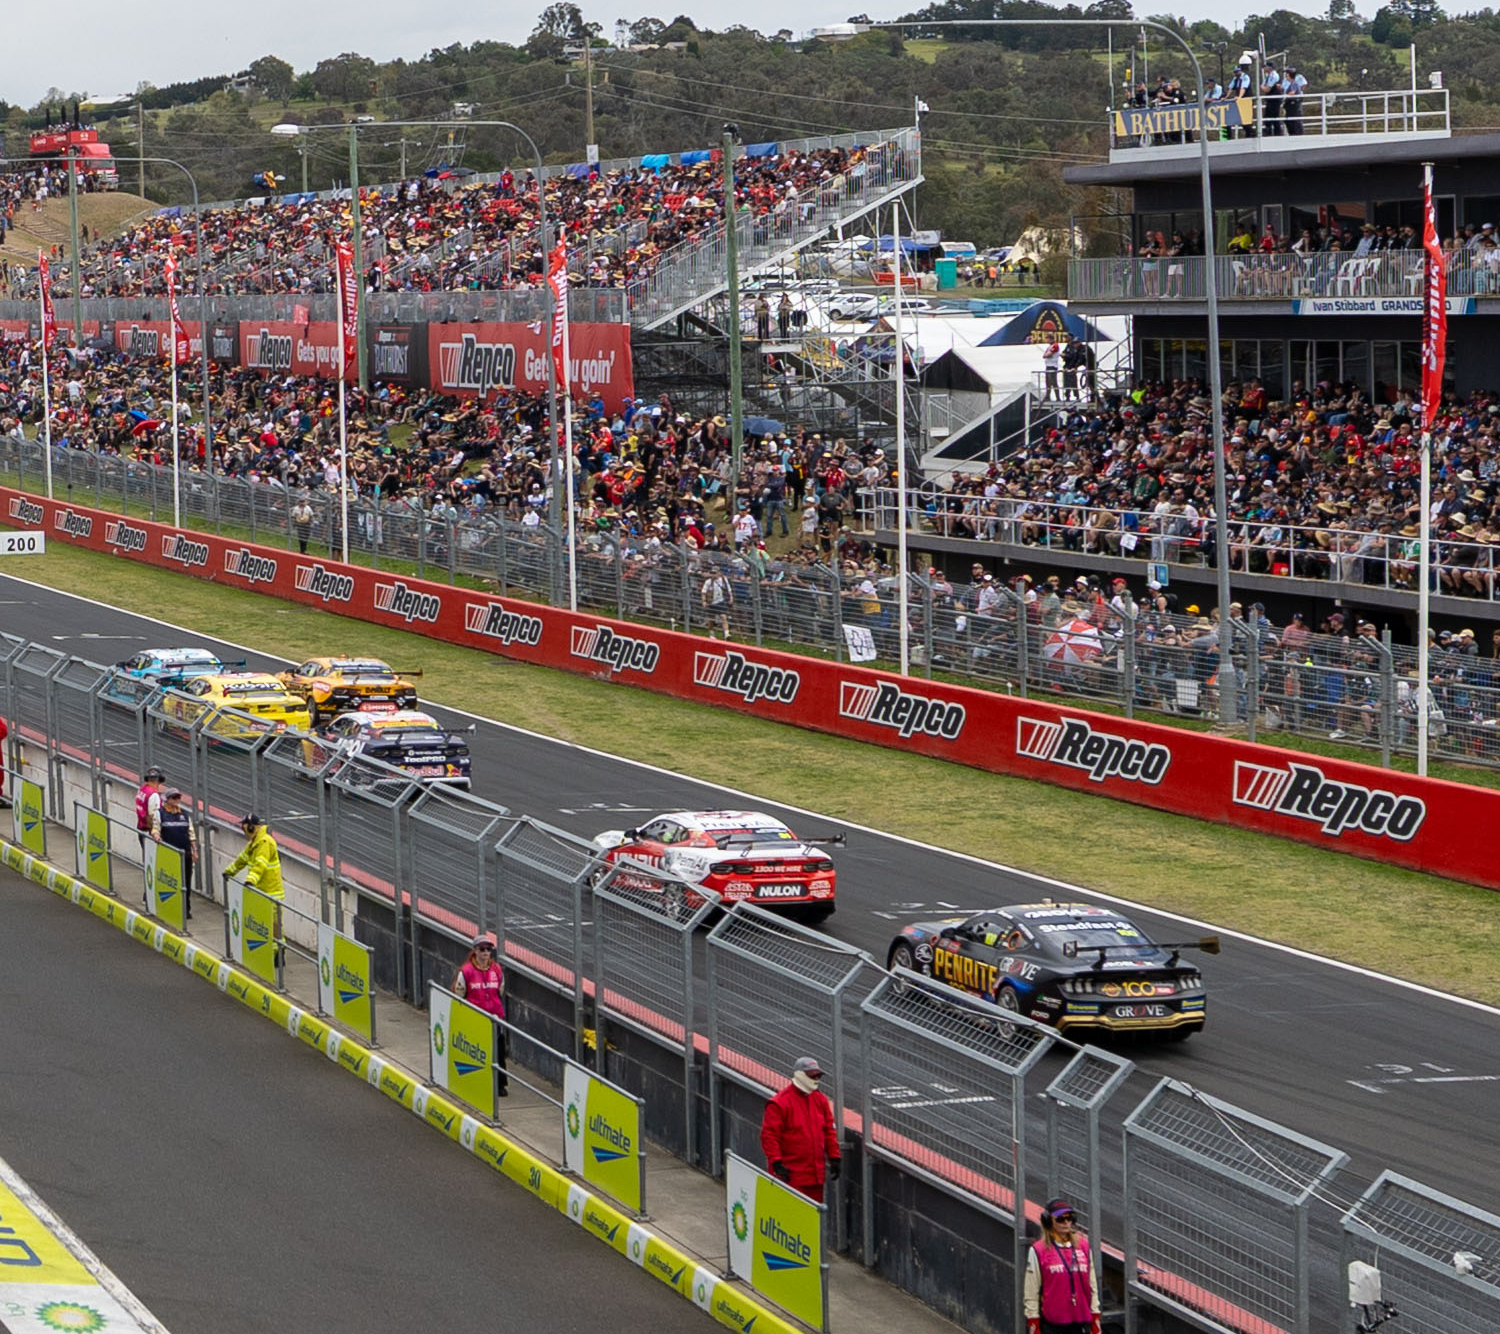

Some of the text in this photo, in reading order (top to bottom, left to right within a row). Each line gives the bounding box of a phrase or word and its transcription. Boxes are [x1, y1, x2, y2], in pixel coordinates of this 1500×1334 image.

[1313, 300, 1452, 312] Ivan Stibbard GRANDSD
[259, 327, 293, 369] Repco
[297, 339, 315, 361] Gets
[459, 332, 517, 399] Repco
[19, 497, 44, 525] Repco
[64, 509, 93, 539] Repco
[6, 538, 36, 552] 200
[116, 520, 148, 552] Repco
[174, 533, 210, 568] Repco
[236, 547, 278, 584] Repco
[310, 563, 355, 603] Repco
[389, 581, 442, 624] Repco
[484, 601, 543, 646] Repco
[590, 624, 661, 673] Repco
[716, 650, 801, 704] Repco
[870, 680, 967, 739] Repco
[404, 755, 446, 763] ToolPRO
[1050, 717, 1172, 786] Repco
[1274, 761, 1427, 842] Repco
[156, 866, 178, 890] ultimate
[758, 884, 801, 897] NULON
[243, 914, 270, 941] ultimate
[1039, 921, 1115, 934] Steadfast
[335, 962, 365, 993] ultimate
[935, 947, 998, 994] PENRITE
[1000, 957, 1041, 981] GROVE
[262, 994, 271, 1014] 29
[1121, 981, 1156, 997] 100
[1115, 1004, 1166, 1017] GROVE
[452, 1031, 487, 1065] ultimate
[589, 1114, 632, 1154] ultimate
[528, 1166, 541, 1191] 30
[759, 1215, 812, 1262] ultimate
[647, 1251, 674, 1279] ultimate
[716, 1298, 746, 1326] ultimate
